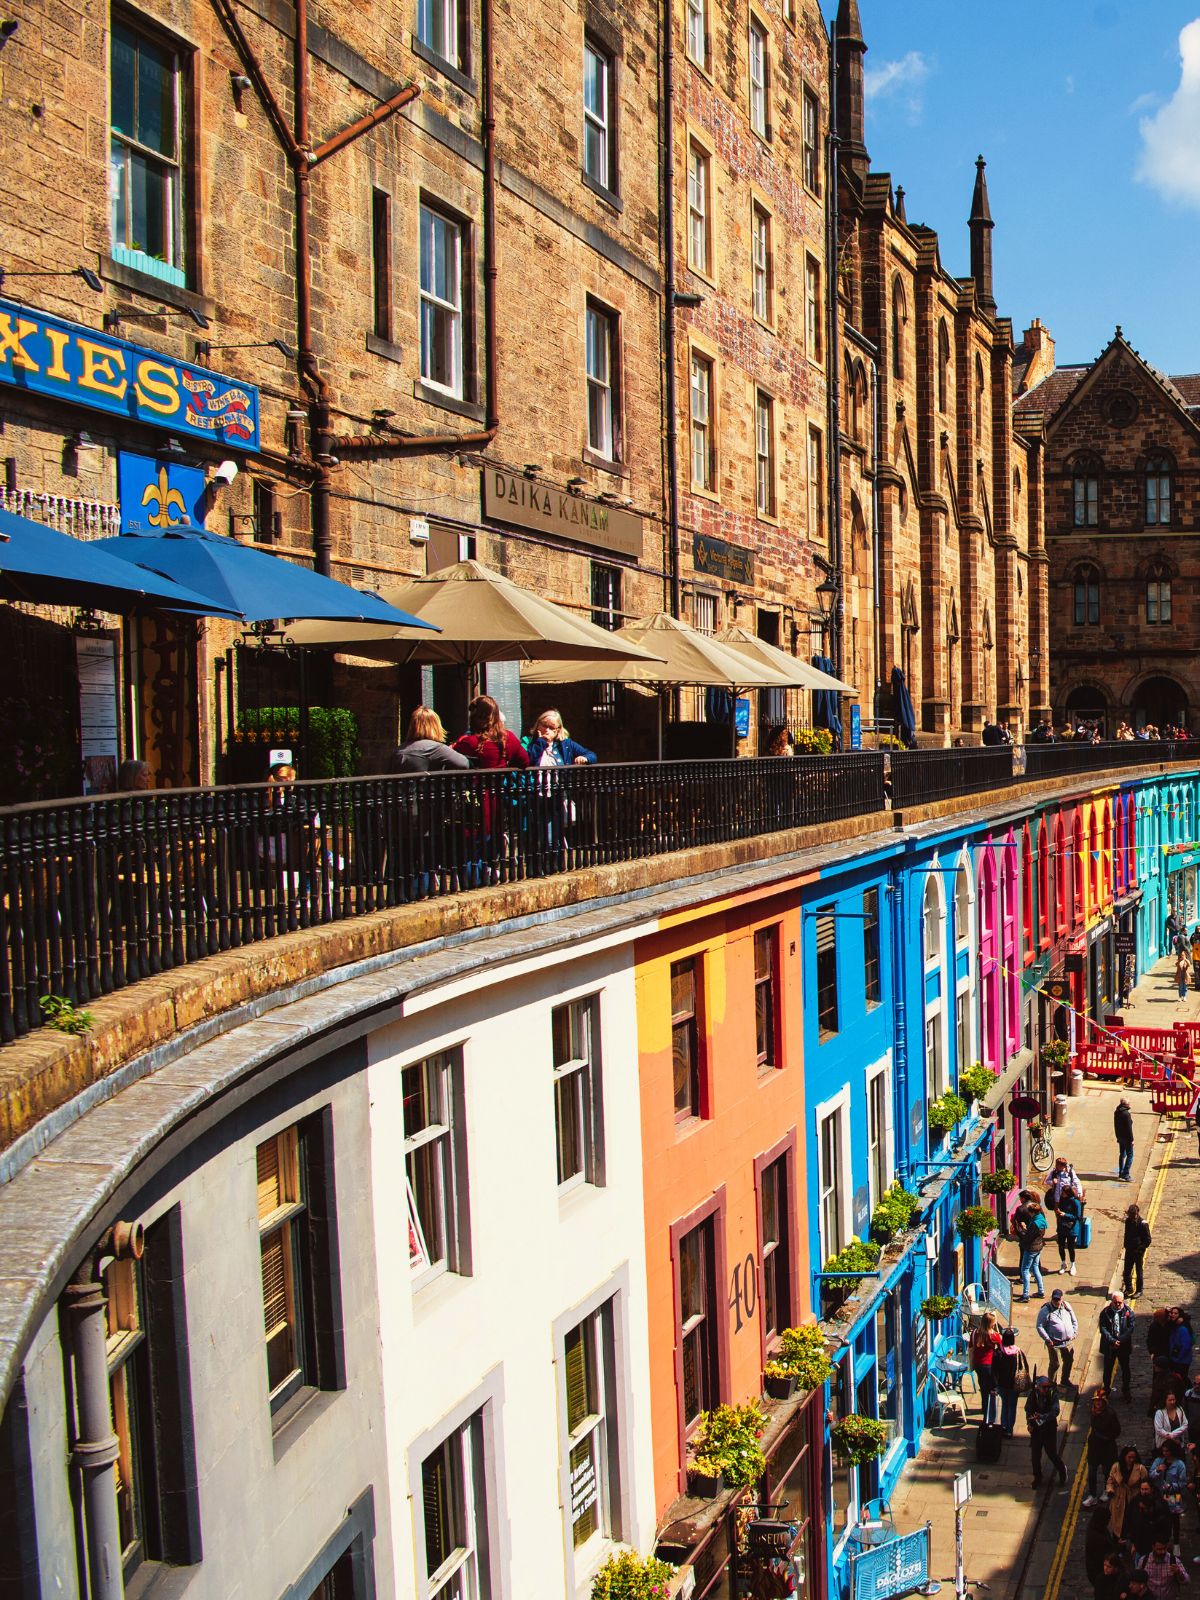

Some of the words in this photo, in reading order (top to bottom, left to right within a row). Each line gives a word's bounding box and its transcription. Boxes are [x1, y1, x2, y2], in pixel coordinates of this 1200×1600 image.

[209, 395, 230, 409] WINE
[229, 389, 247, 404] BAR
[495, 472, 552, 516] DAIKA
[559, 495, 609, 532] KANAM
[728, 1252, 756, 1336] 40
